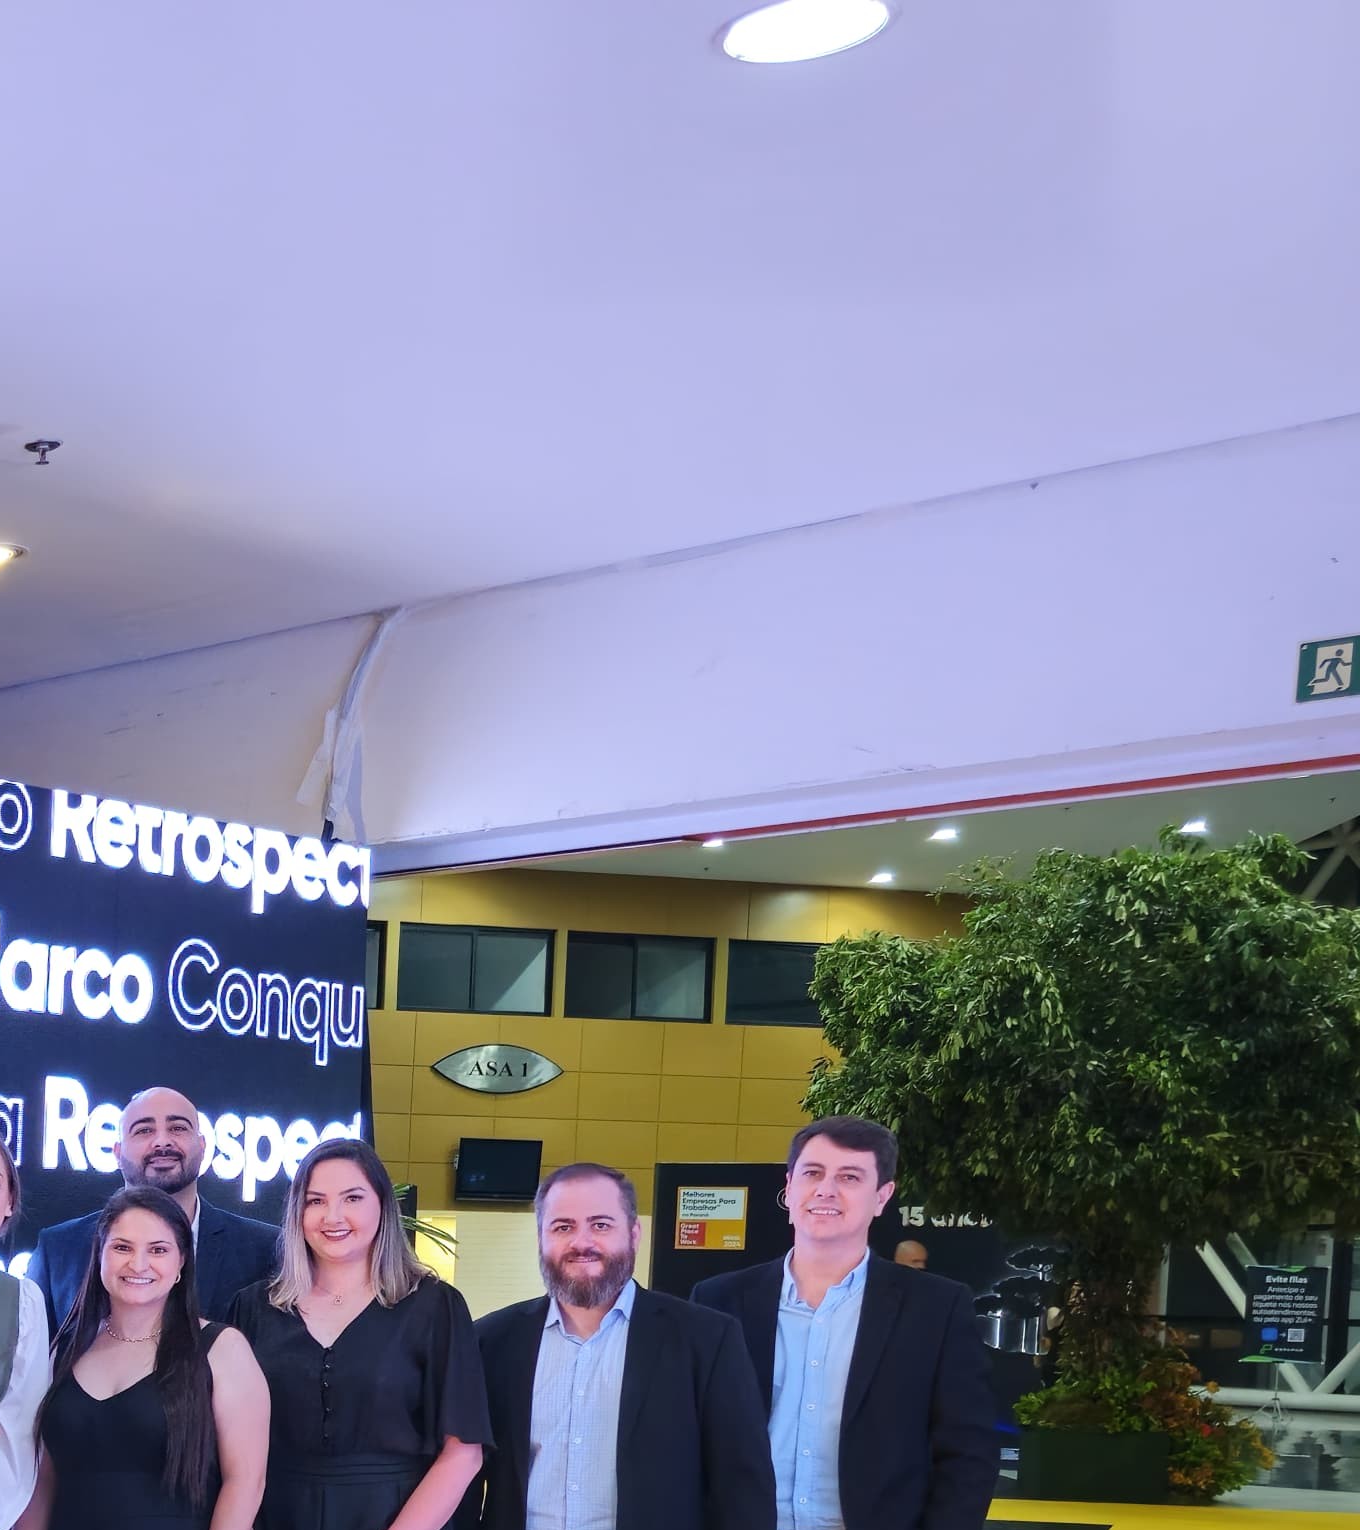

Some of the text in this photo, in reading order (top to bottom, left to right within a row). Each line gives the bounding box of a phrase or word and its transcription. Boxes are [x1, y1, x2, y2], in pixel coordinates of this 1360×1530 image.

[168, 937, 365, 1066] Conqu
[468, 1061, 529, 1077] ASA 1
[682, 1198, 717, 1206] Empresas
[898, 1206, 925, 1227] 15
[1265, 1275, 1308, 1284] Evite filas
[1267, 1286, 1298, 1294] Antecipe
